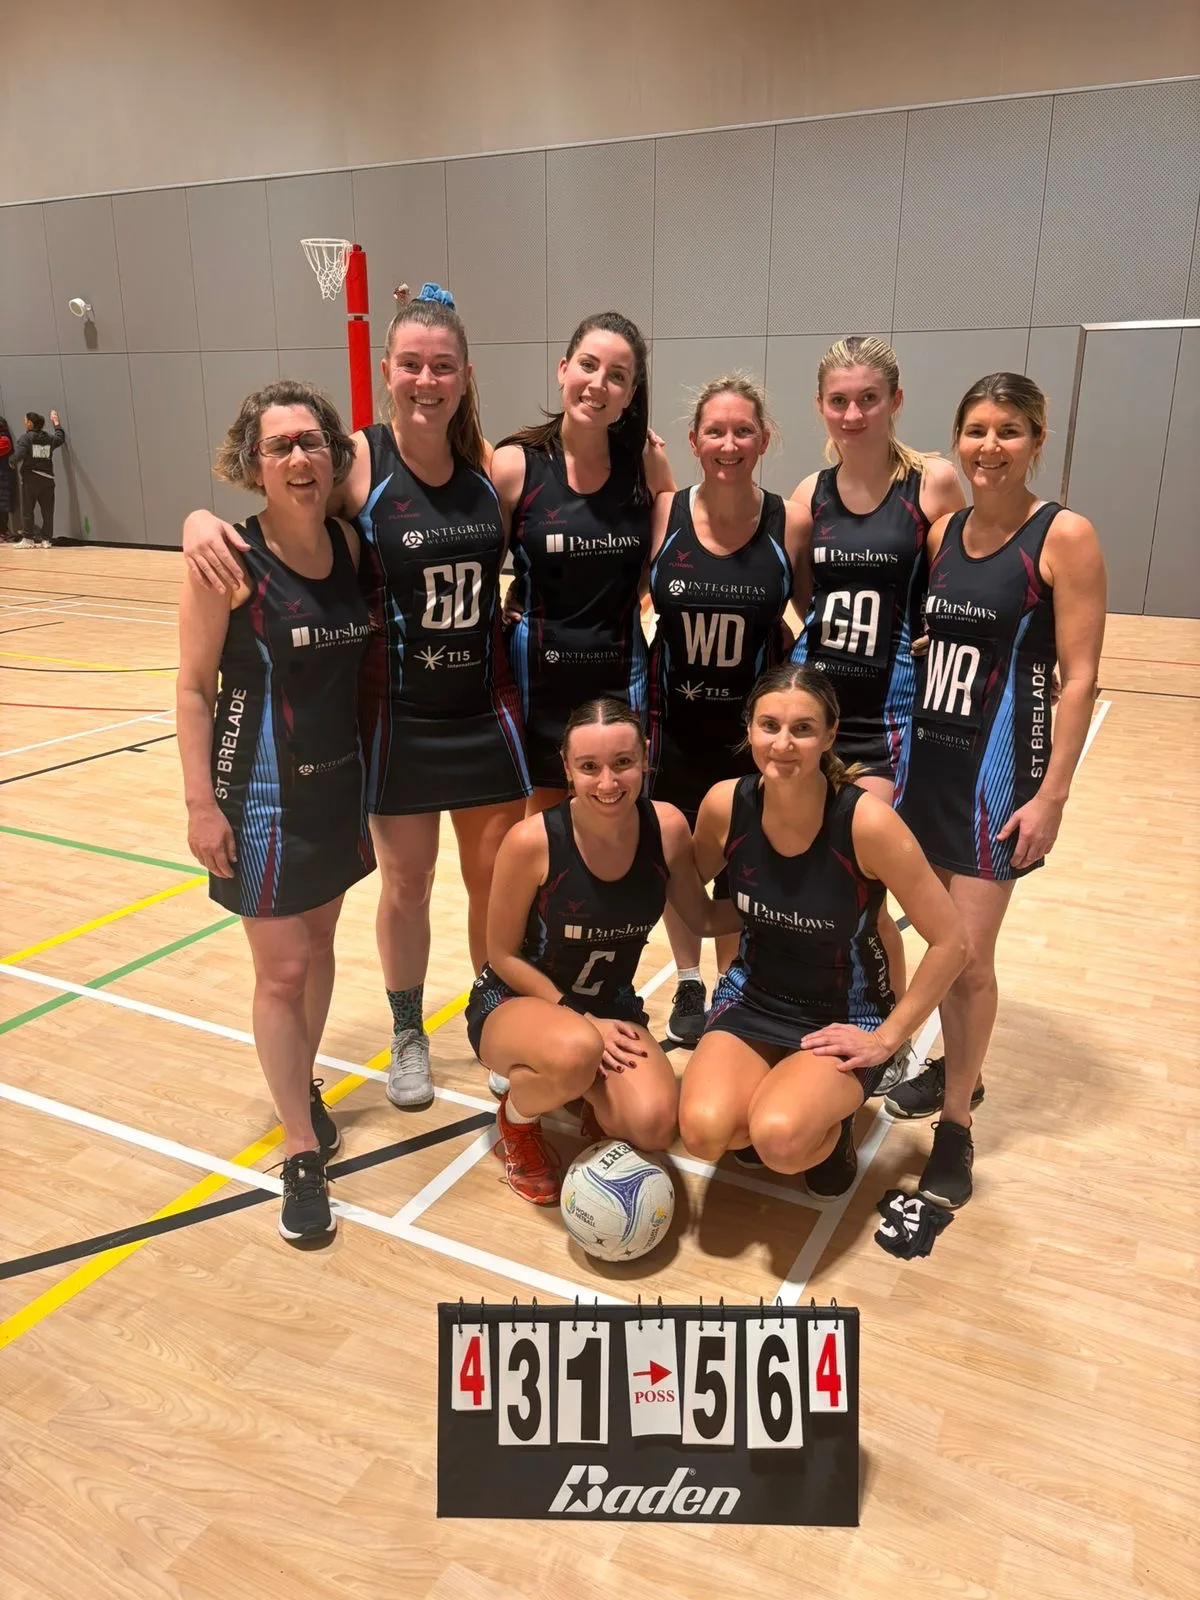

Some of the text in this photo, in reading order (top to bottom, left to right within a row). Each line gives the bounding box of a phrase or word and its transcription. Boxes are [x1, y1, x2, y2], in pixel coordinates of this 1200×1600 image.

[425, 523, 498, 538] INTEGRITAS
[568, 533, 641, 551] Parslows
[830, 548, 898, 564] Parslows
[421, 561, 482, 629] GD
[687, 581, 766, 595] INTEGRITAS
[935, 598, 997, 621] Parslows
[820, 590, 881, 657] GA
[681, 612, 746, 667] WD
[447, 650, 471, 662] T15
[705, 687, 730, 697] T15
[1031, 663, 1046, 778] ST BRELADE
[214, 688, 247, 800] ST BRELADE
[753, 901, 835, 930] Parslows
[572, 950, 616, 996] C
[576, 1207, 594, 1220] WORLD
[460, 1336, 485, 1406] 4
[816, 1333, 842, 1407] 4
[634, 1389, 675, 1405] POSS
[548, 1464, 741, 1516] Baden
